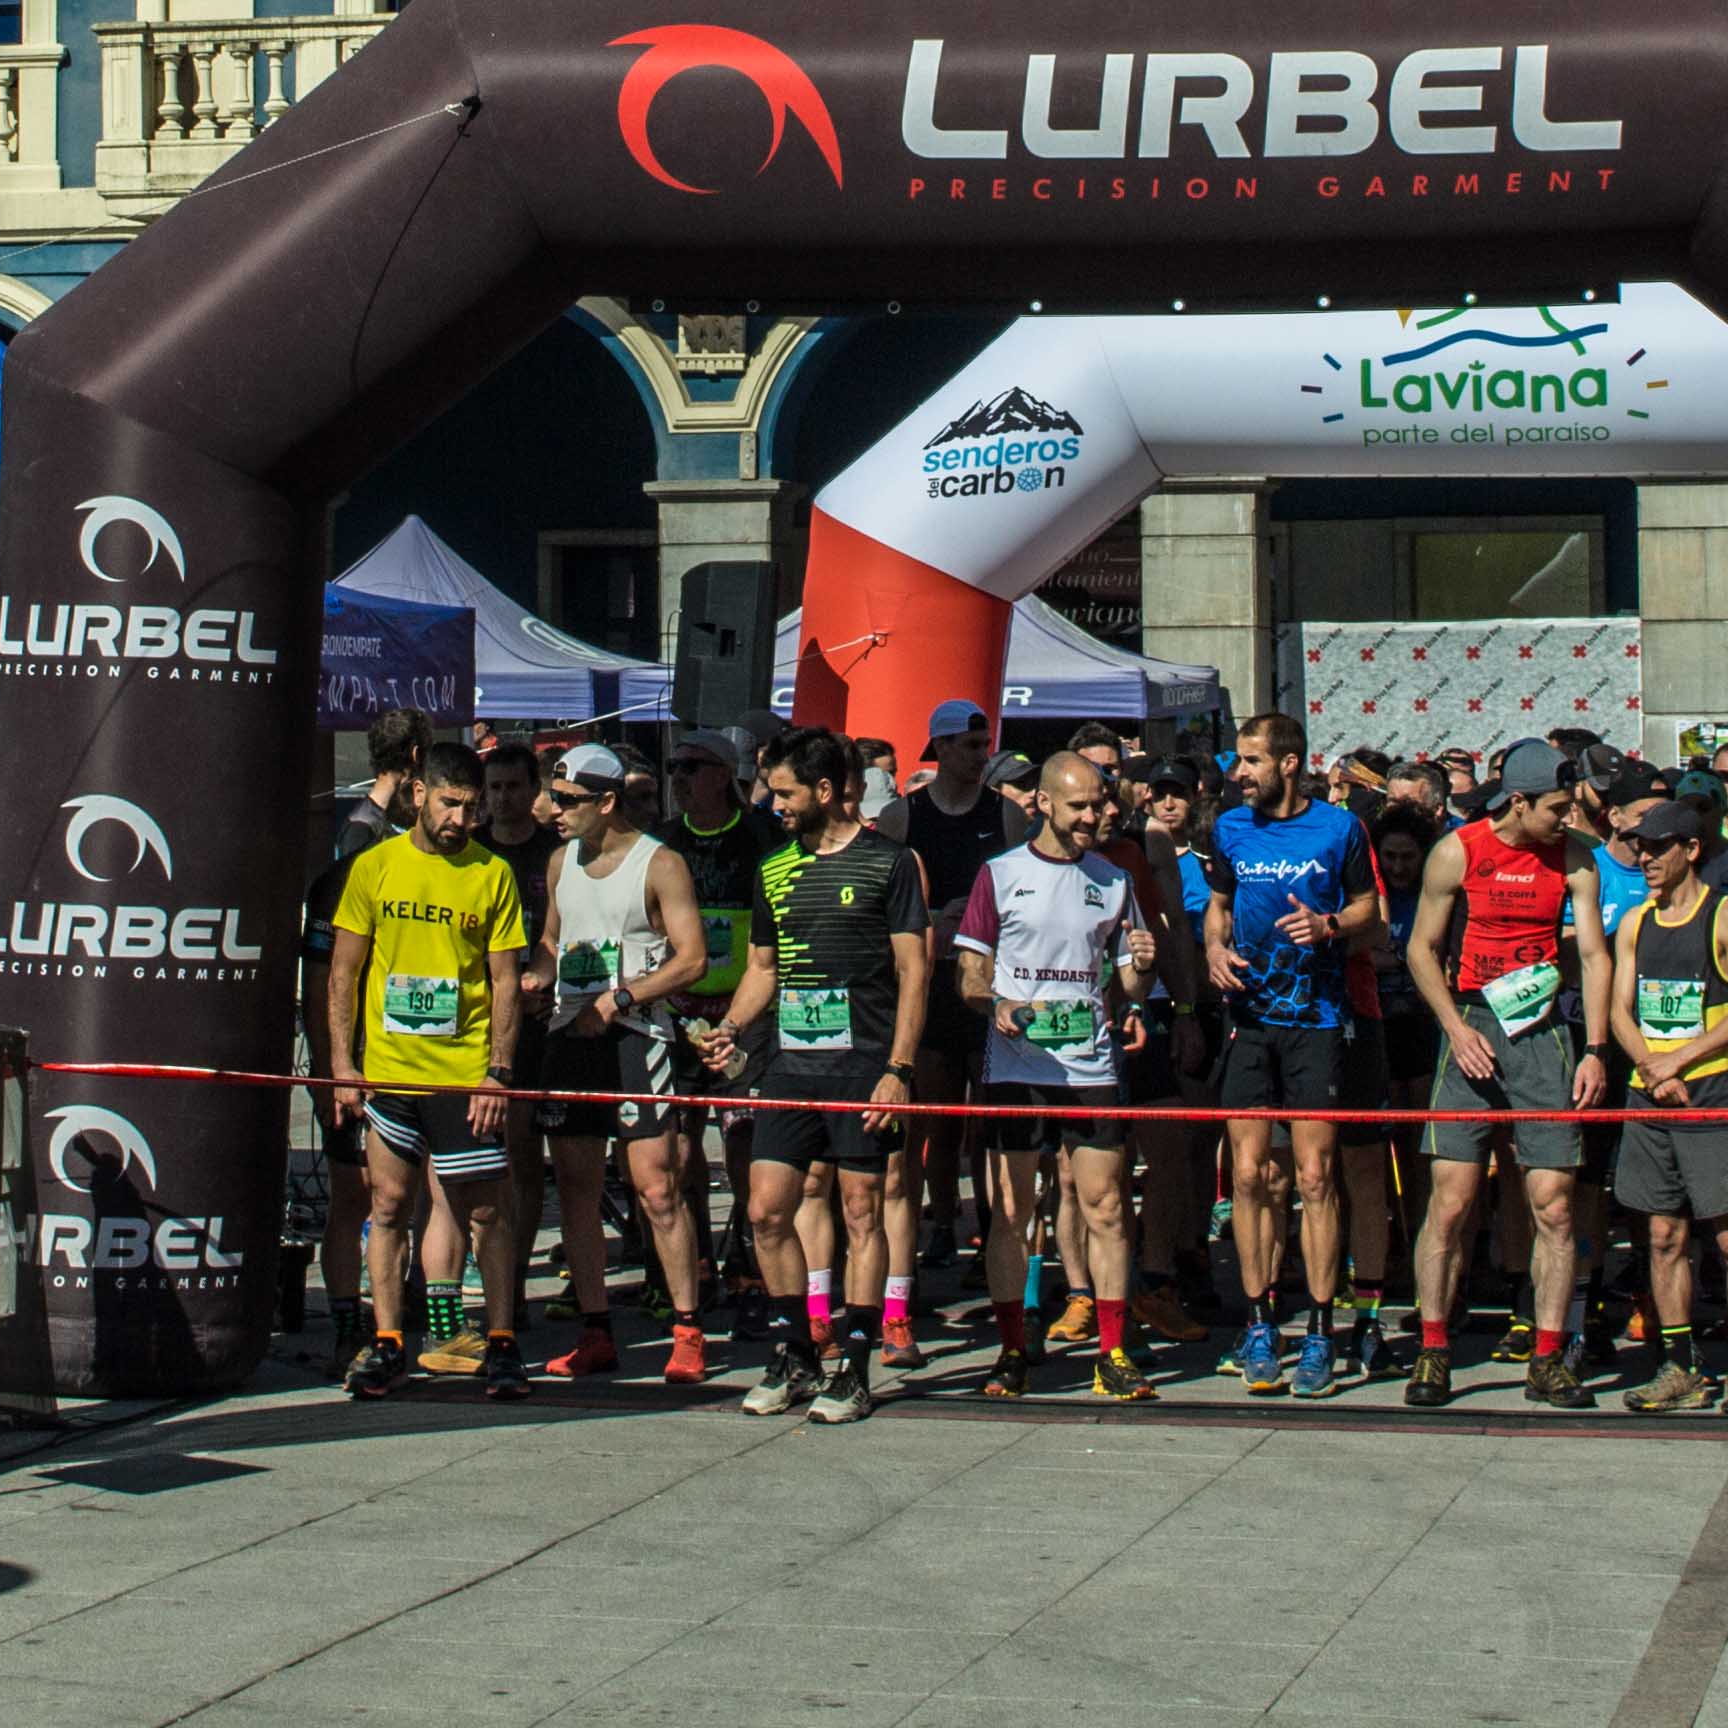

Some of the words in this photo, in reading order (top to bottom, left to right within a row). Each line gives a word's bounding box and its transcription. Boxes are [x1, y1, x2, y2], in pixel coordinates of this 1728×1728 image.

[901, 38, 1624, 159] LURBEL
[909, 176, 1260, 200] PRECISION
[1318, 167, 1619, 197] GARMENT
[1360, 358, 1608, 414] Laviana
[1362, 426, 1440, 449] parte
[1450, 422, 1495, 445] del
[923, 435, 1081, 473] senderos
[928, 476, 940, 499] del
[147, 666, 273, 684] GARMENT
[382, 900, 453, 926] KELER
[459, 912, 479, 930] 18
[134, 966, 257, 980] GARMENT
[407, 990, 434, 1011] 130
[1659, 995, 1680, 1016] 107
[805, 1005, 821, 1024] 21
[1050, 1013, 1069, 1036] 43
[41, 1214, 243, 1269] RBEL
